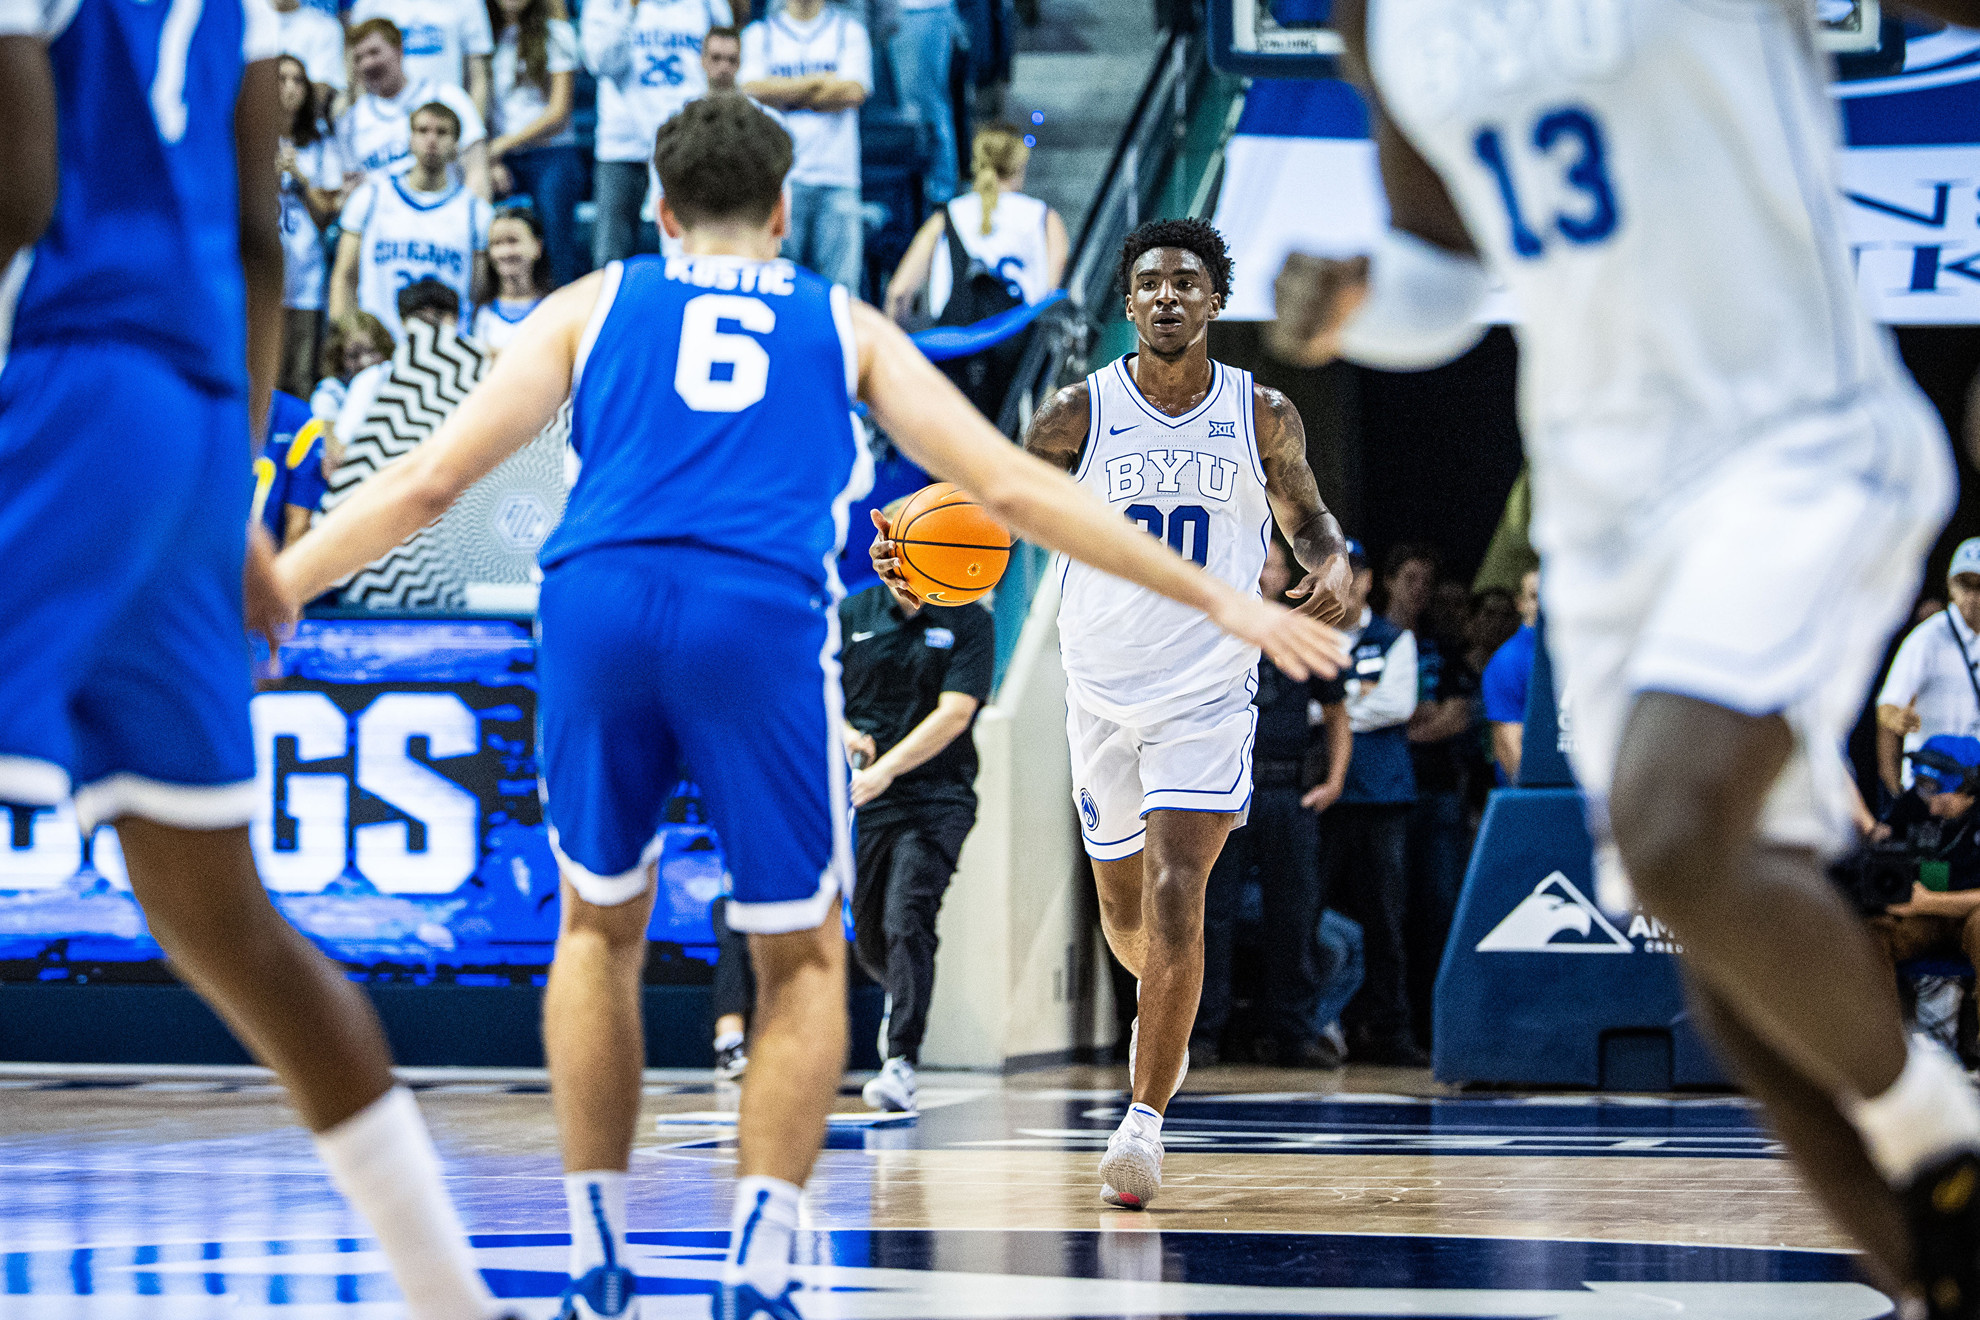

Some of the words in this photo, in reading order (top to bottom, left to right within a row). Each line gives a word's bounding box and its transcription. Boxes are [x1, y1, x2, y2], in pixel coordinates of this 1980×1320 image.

[1475, 105, 1616, 257] 13
[674, 293, 776, 412] 6
[1105, 449, 1239, 503] BYU
